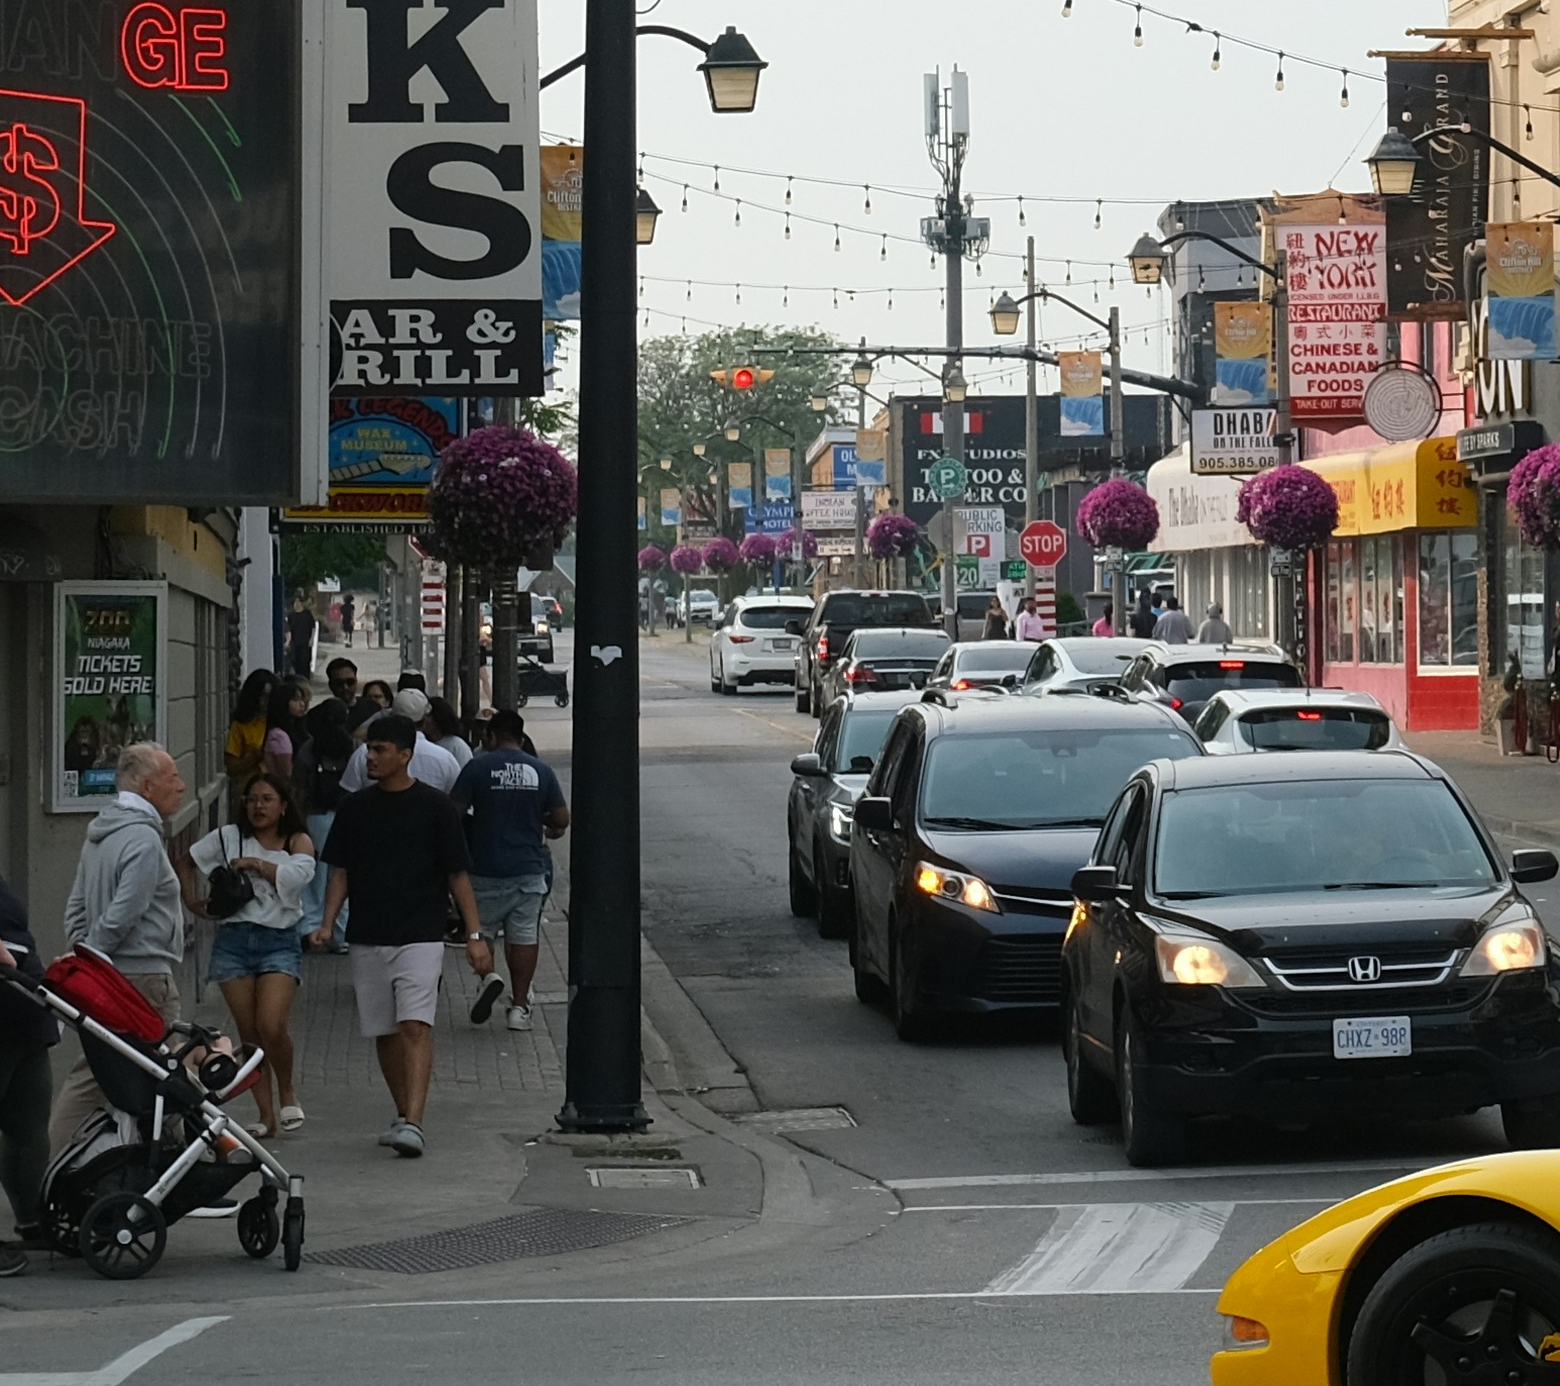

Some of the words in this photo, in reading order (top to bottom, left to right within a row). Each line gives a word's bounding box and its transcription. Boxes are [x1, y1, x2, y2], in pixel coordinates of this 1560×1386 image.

[1315, 231, 1378, 261] NEW
[1315, 262, 1377, 290] YORK
[1288, 304, 1380, 321] RESTAURANT
[342, 308, 442, 344] AR
[466, 309, 517, 344] &
[1291, 343, 1362, 357] CHINESE
[1367, 343, 1378, 355] &
[339, 349, 518, 386] RILL
[1292, 361, 1379, 375] CANADIAN
[1307, 379, 1364, 392] FOODS
[1230, 436, 1245, 448] THE
[1250, 436, 1271, 448] FALL
[303, 524, 404, 534] ESTABLISHED
[967, 522, 1002, 532] RKING
[1023, 536, 1062, 553] STOP
[88, 637, 130, 650] NIAGARA
[78, 655, 142, 673] TICKETS
[64, 677, 105, 695] SOLD
[109, 676, 153, 694] HERE
[1337, 1029, 1372, 1049] CHXZ
